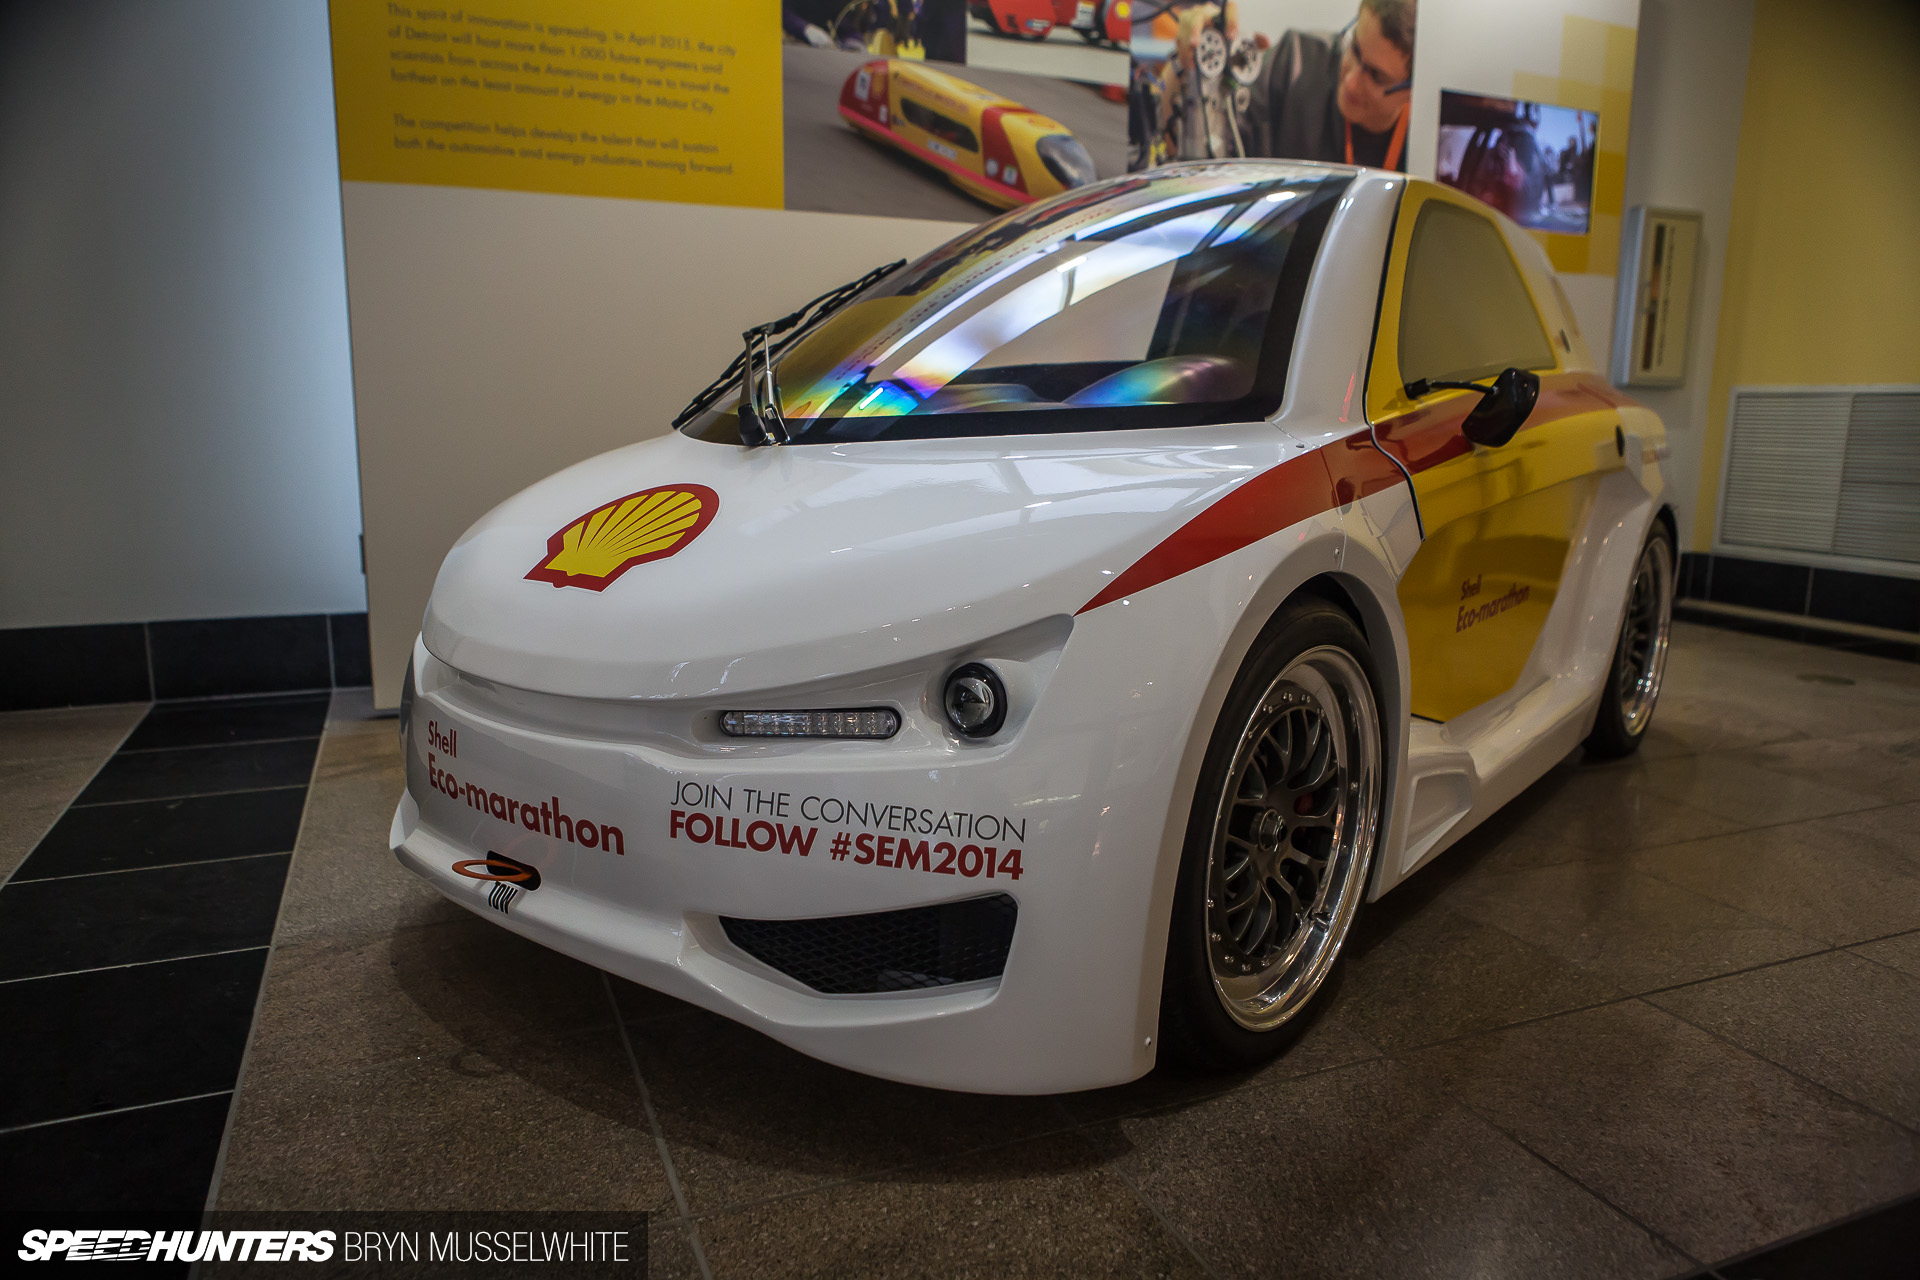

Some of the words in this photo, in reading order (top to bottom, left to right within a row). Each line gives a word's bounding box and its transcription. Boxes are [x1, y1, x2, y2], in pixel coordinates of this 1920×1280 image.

[1455, 582, 1530, 634] Eco-marathon
[1460, 574, 1482, 601] Shell
[428, 720, 457, 758] Shell
[428, 751, 625, 856] Eco-marathon
[670, 780, 733, 811] JOIN
[743, 788, 791, 818] THE
[800, 796, 1026, 843] CONVERSATION
[669, 809, 819, 857] FOLLOW
[829, 831, 1024, 881] #SEM2014
[487, 880, 519, 915] TOW
